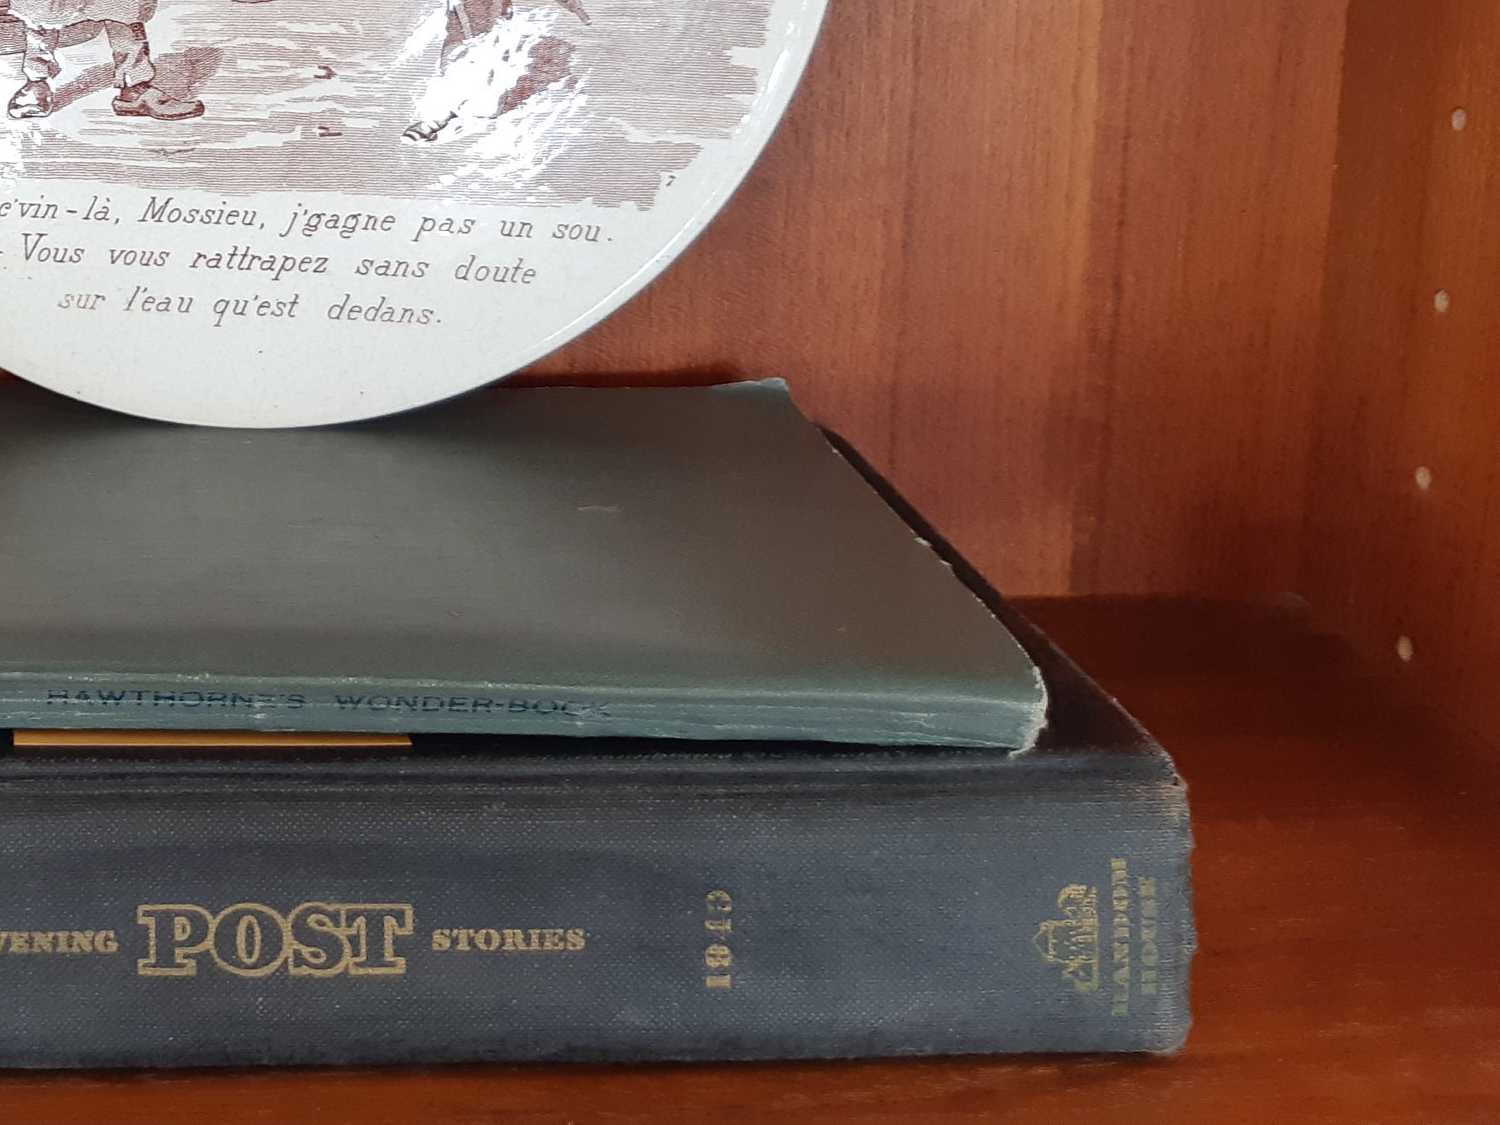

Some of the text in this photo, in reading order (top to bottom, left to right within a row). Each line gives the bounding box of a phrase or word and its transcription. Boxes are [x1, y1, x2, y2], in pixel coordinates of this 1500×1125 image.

[138, 195, 265, 230] Mossieu,
[279, 203, 396, 239] j'gagne
[411, 215, 476, 242] pas
[500, 219, 534, 239] un
[552, 222, 614, 243] sou.
[21, 232, 85, 264] Vous
[109, 246, 170, 268] vous
[189, 245, 329, 281] rattrapez
[355, 257, 430, 280] sans
[454, 254, 537, 285] doute
[57, 286, 443, 327] sur l'eau qu'est dedans.
[136, 902, 415, 977] POST
[431, 927, 587, 952] STORIES
